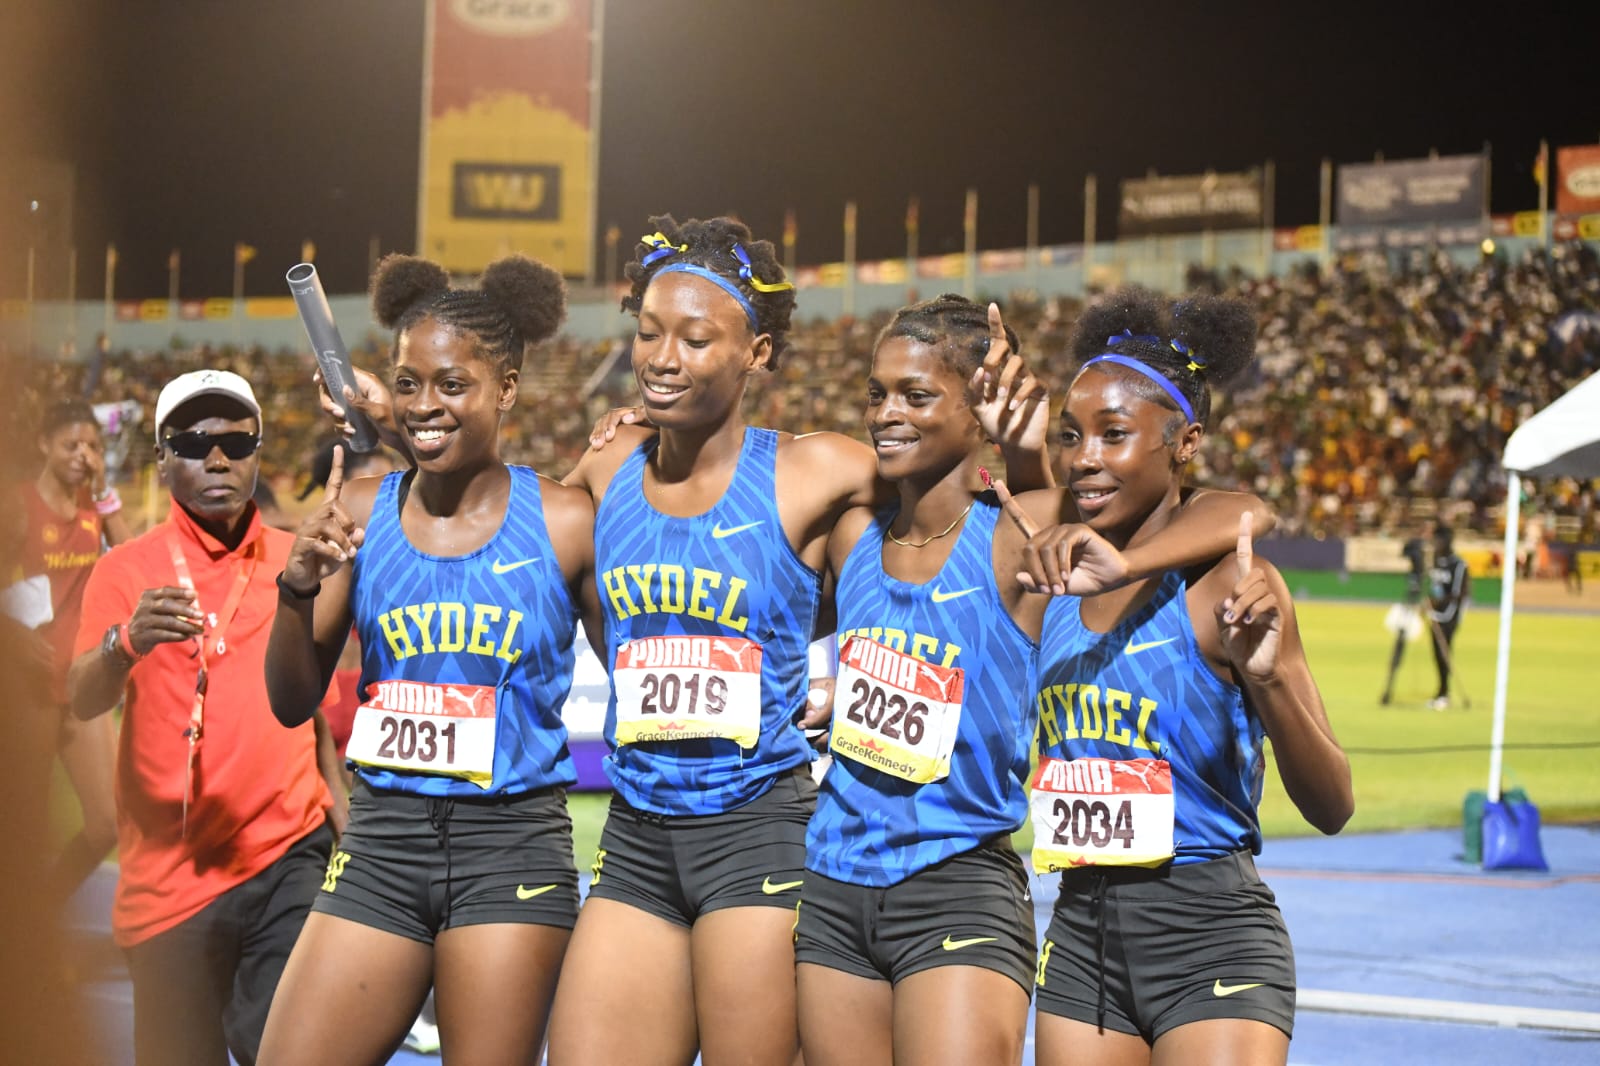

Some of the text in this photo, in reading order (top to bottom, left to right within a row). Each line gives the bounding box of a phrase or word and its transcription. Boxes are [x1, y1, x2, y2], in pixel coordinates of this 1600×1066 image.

[602, 563, 748, 632] HYDEL
[378, 602, 523, 664] HYDEL
[628, 638, 710, 668] PUMA
[847, 638, 919, 691] PUMA
[640, 673, 728, 715] 2019
[847, 678, 929, 746] 2026
[1038, 683, 1161, 753] HYDEL
[377, 716, 456, 764] 2031
[836, 736, 917, 777] GraceKennedy
[1052, 798, 1134, 849] 2034
